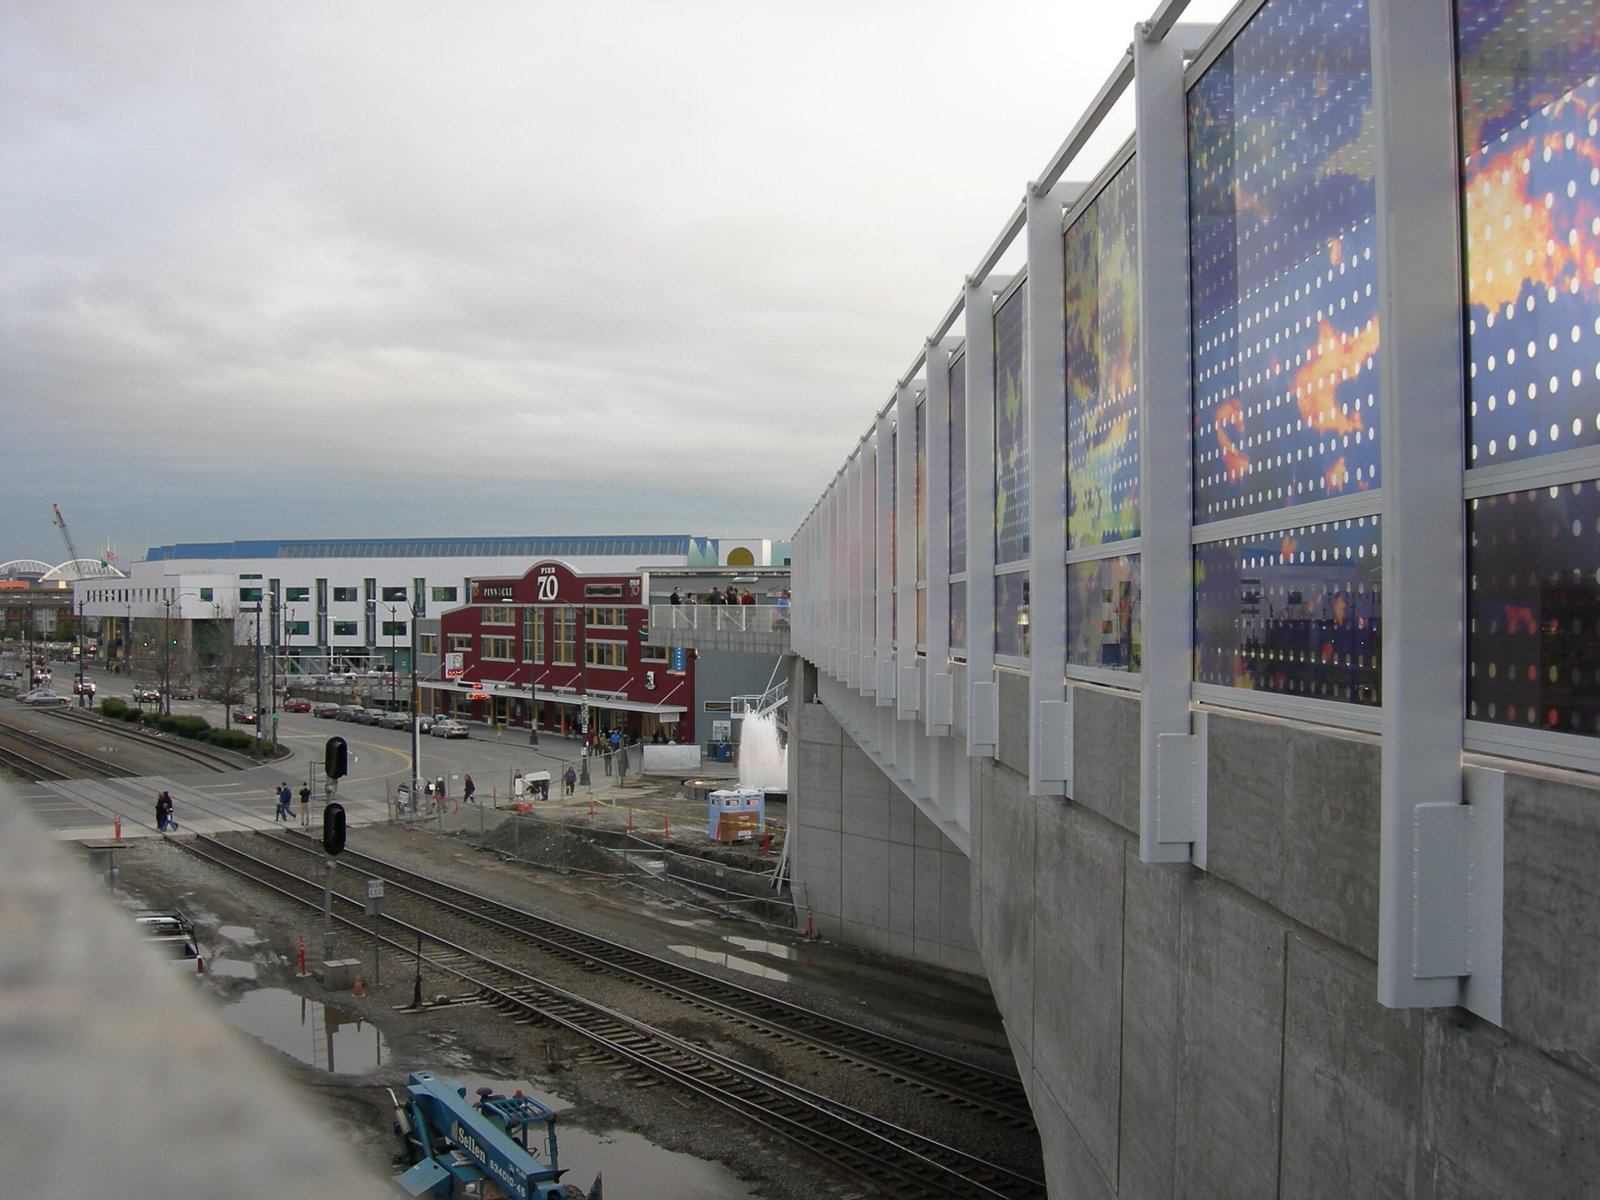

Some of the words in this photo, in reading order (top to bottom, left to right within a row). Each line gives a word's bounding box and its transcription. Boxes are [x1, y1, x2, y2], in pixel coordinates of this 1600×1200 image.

[540, 567, 556, 575] PIER
[537, 574, 559, 601] 70
[458, 1127, 487, 1165] Sellen
